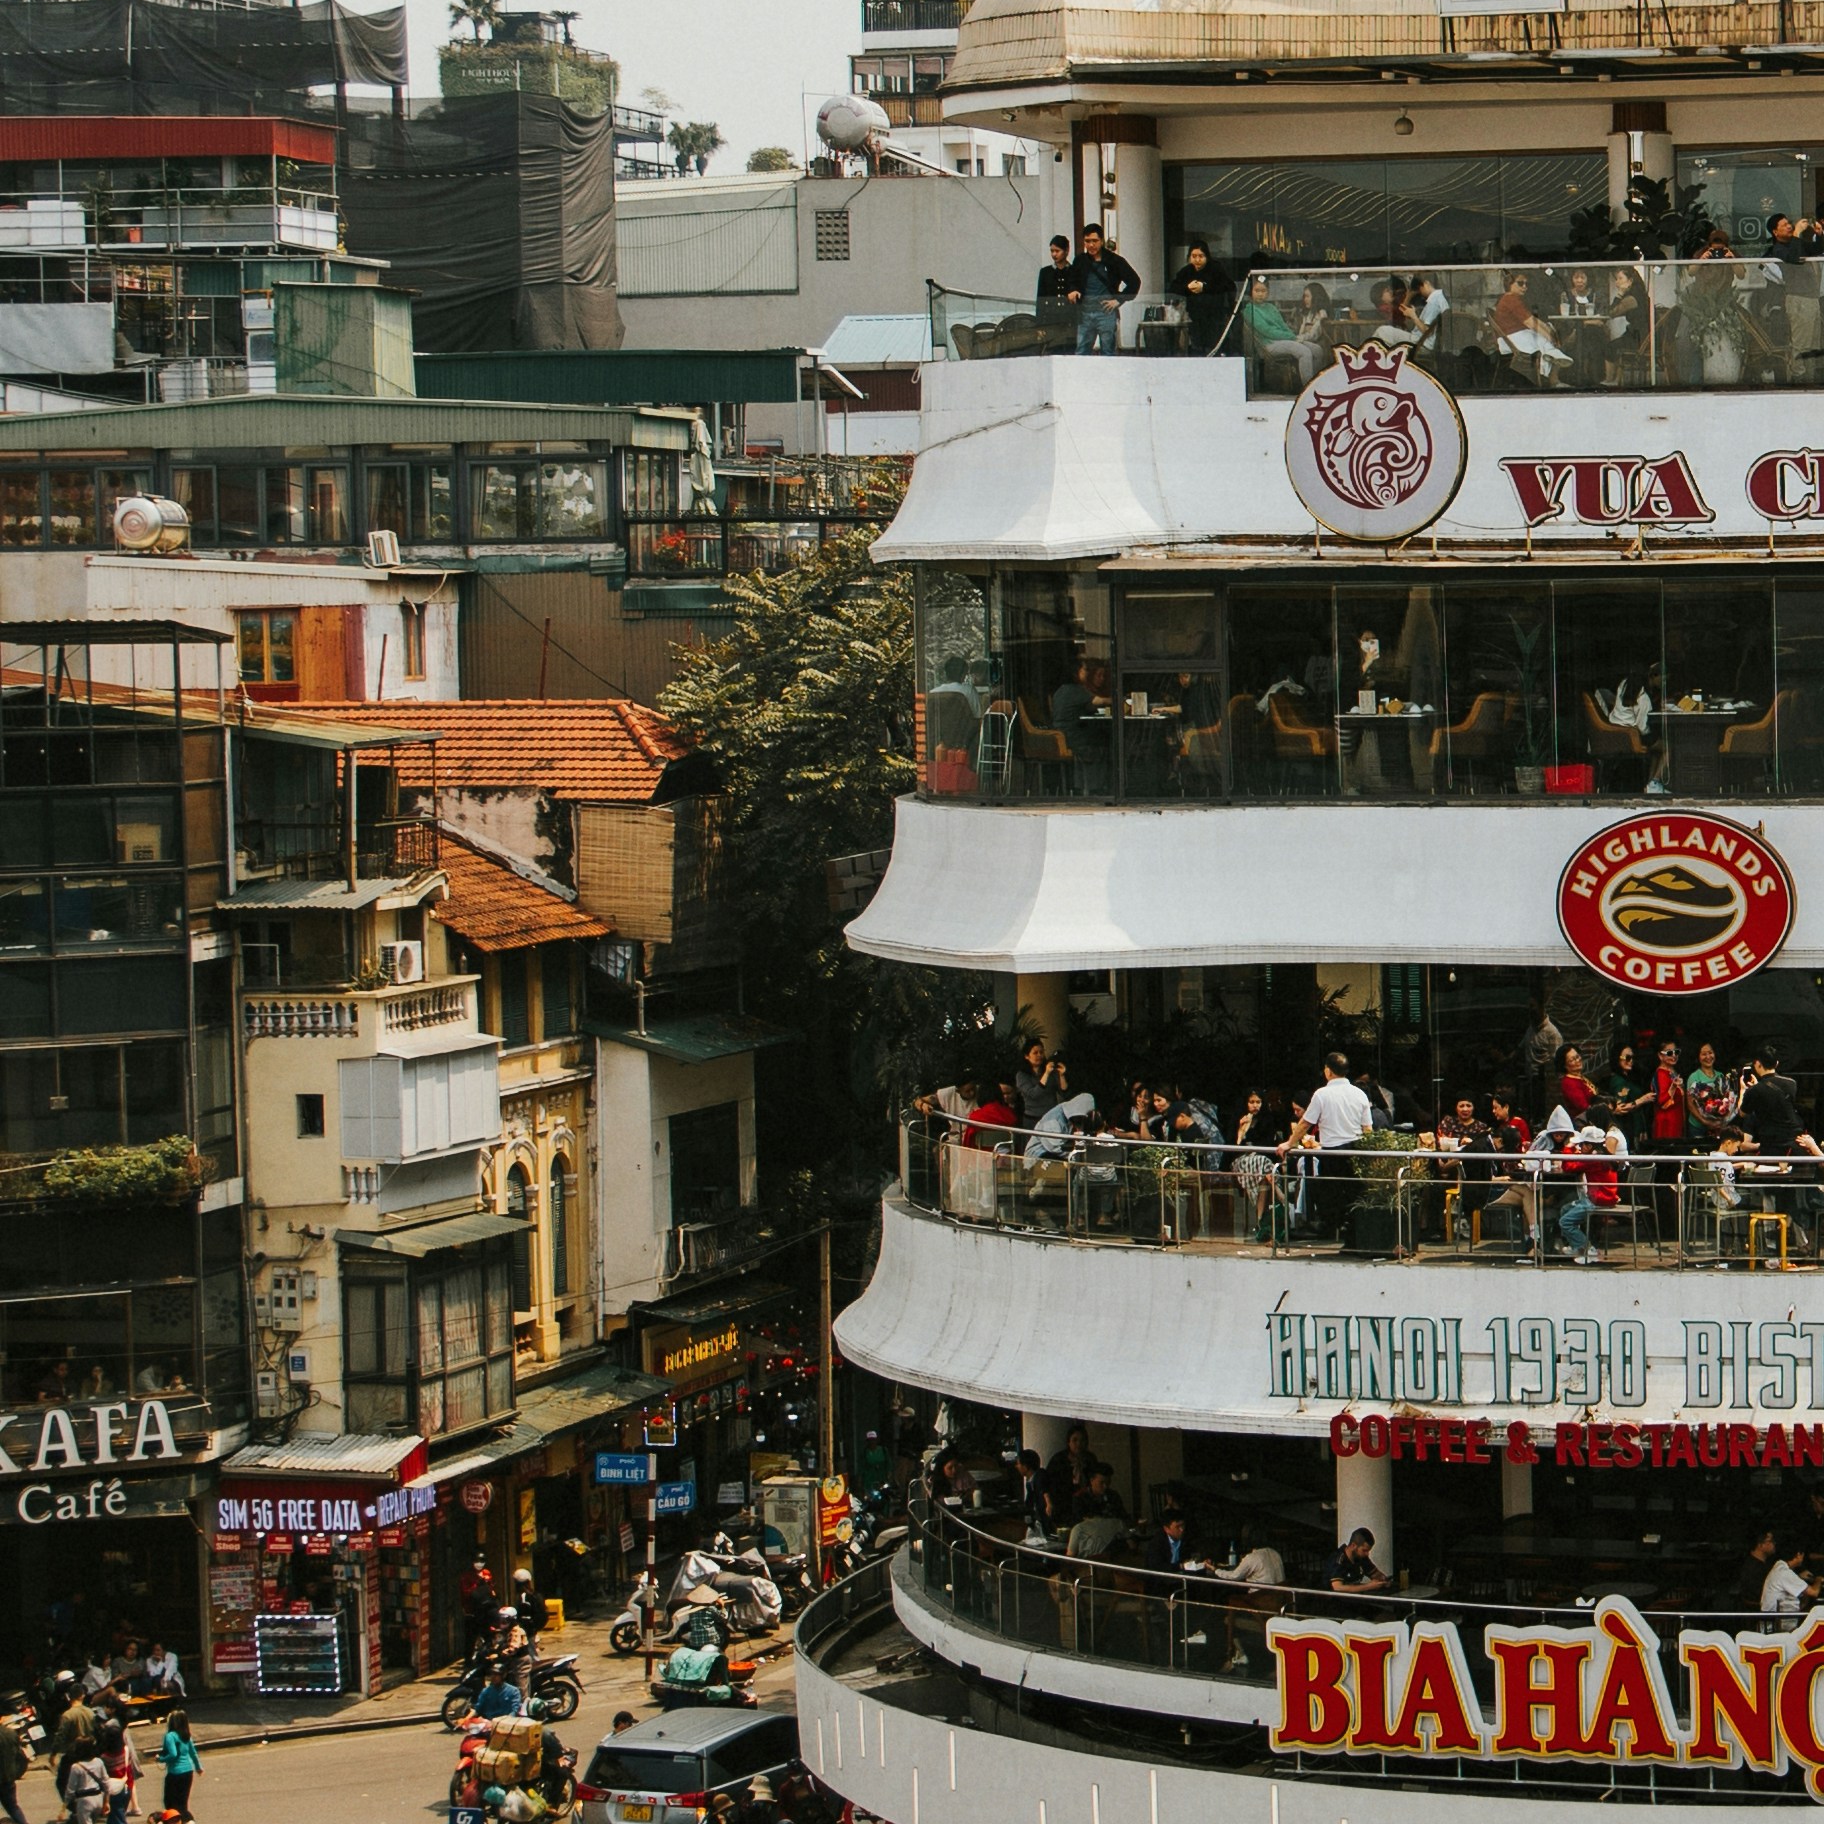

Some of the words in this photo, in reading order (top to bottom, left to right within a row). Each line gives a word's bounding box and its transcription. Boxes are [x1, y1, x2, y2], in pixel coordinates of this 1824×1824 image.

[461, 69, 519, 77] LIGHTHOUS
[1498, 451, 1716, 526] VUA
[1571, 825, 1777, 900] HIGHLANDS
[1598, 940, 1757, 986] COFFEE
[1267, 1312, 1463, 1405] HANOI
[1486, 1316, 1647, 1409] 1930
[1330, 1413, 1491, 1465] COFFEE
[1506, 1420, 1541, 1466] &
[18, 1478, 127, 1524] Café
[219, 1499, 248, 1530] SIM
[252, 1499, 273, 1530] 5G
[278, 1499, 317, 1530] FREE
[321, 1499, 362, 1531] DATA
[1272, 1632, 1484, 1754] BIA
[1488, 1609, 1680, 1763] HÀ
